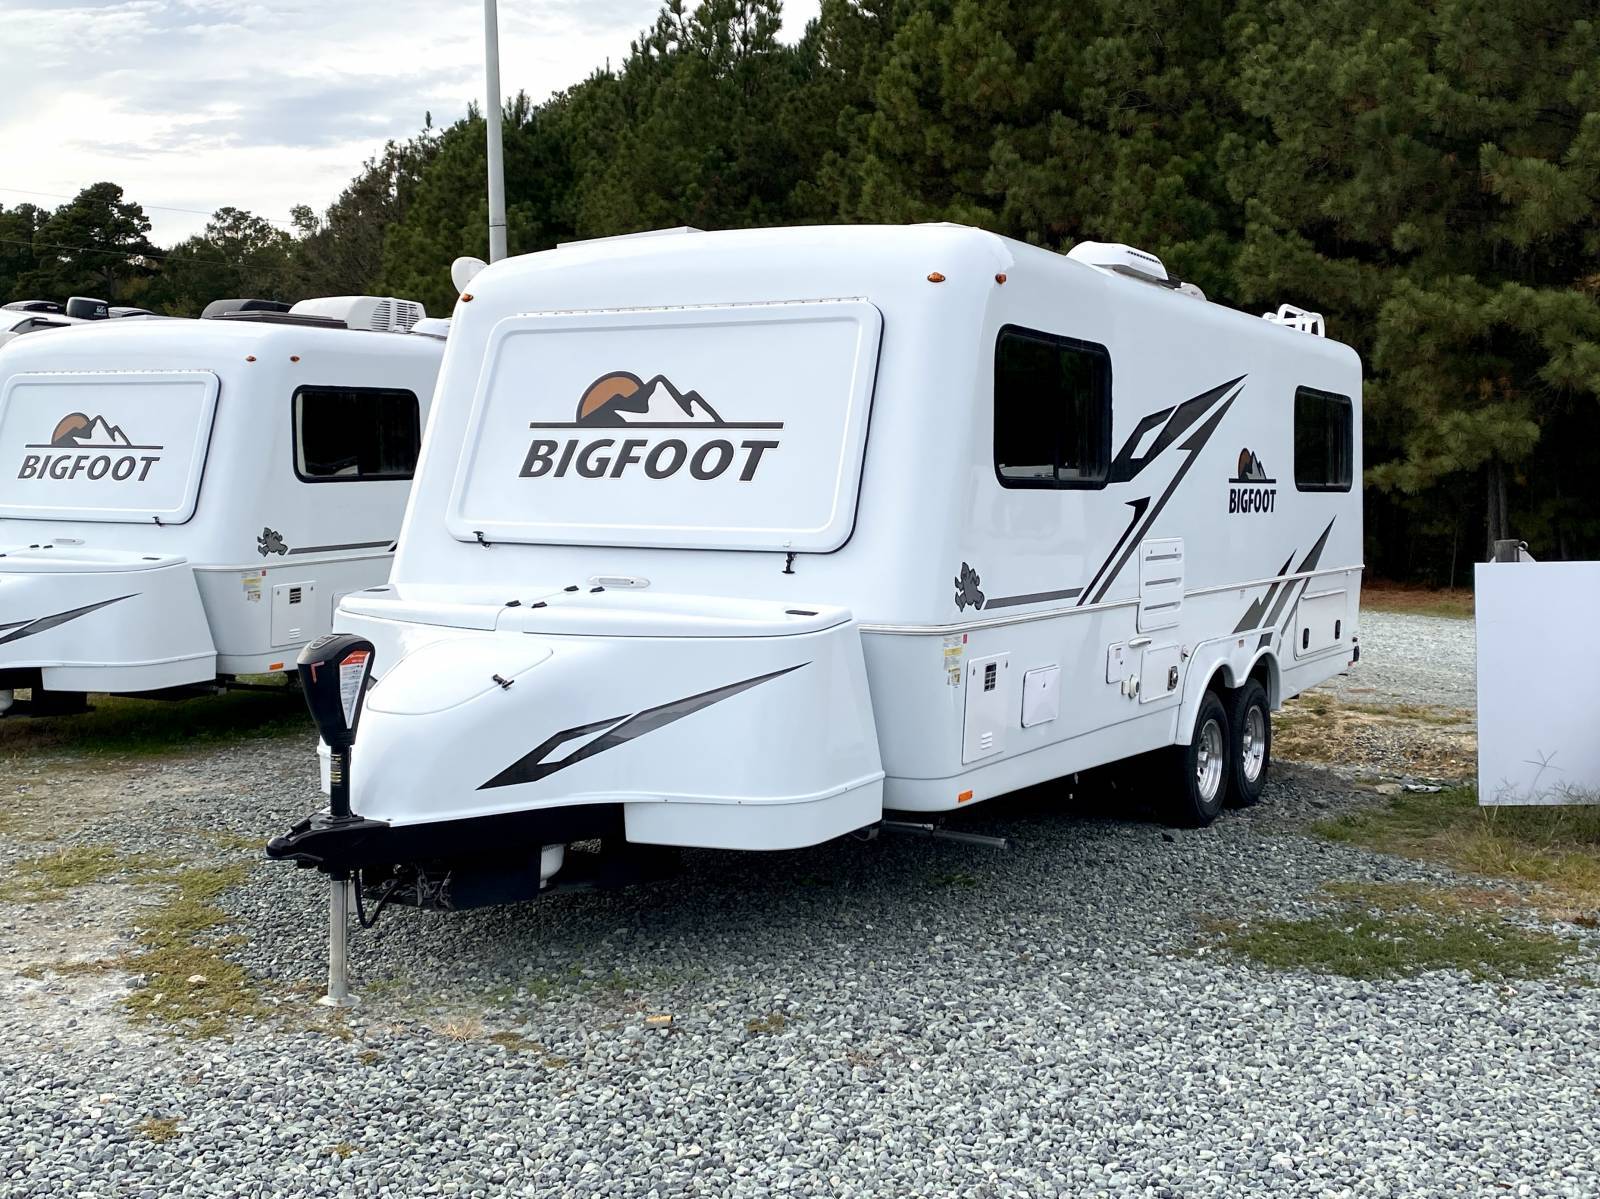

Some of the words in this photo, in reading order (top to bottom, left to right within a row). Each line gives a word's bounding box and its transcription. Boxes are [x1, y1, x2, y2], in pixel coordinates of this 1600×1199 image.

[17, 454, 161, 482] BIGFOOT
[518, 438, 780, 482] BIGFOOT
[1228, 488, 1277, 514] BIGFOOT
